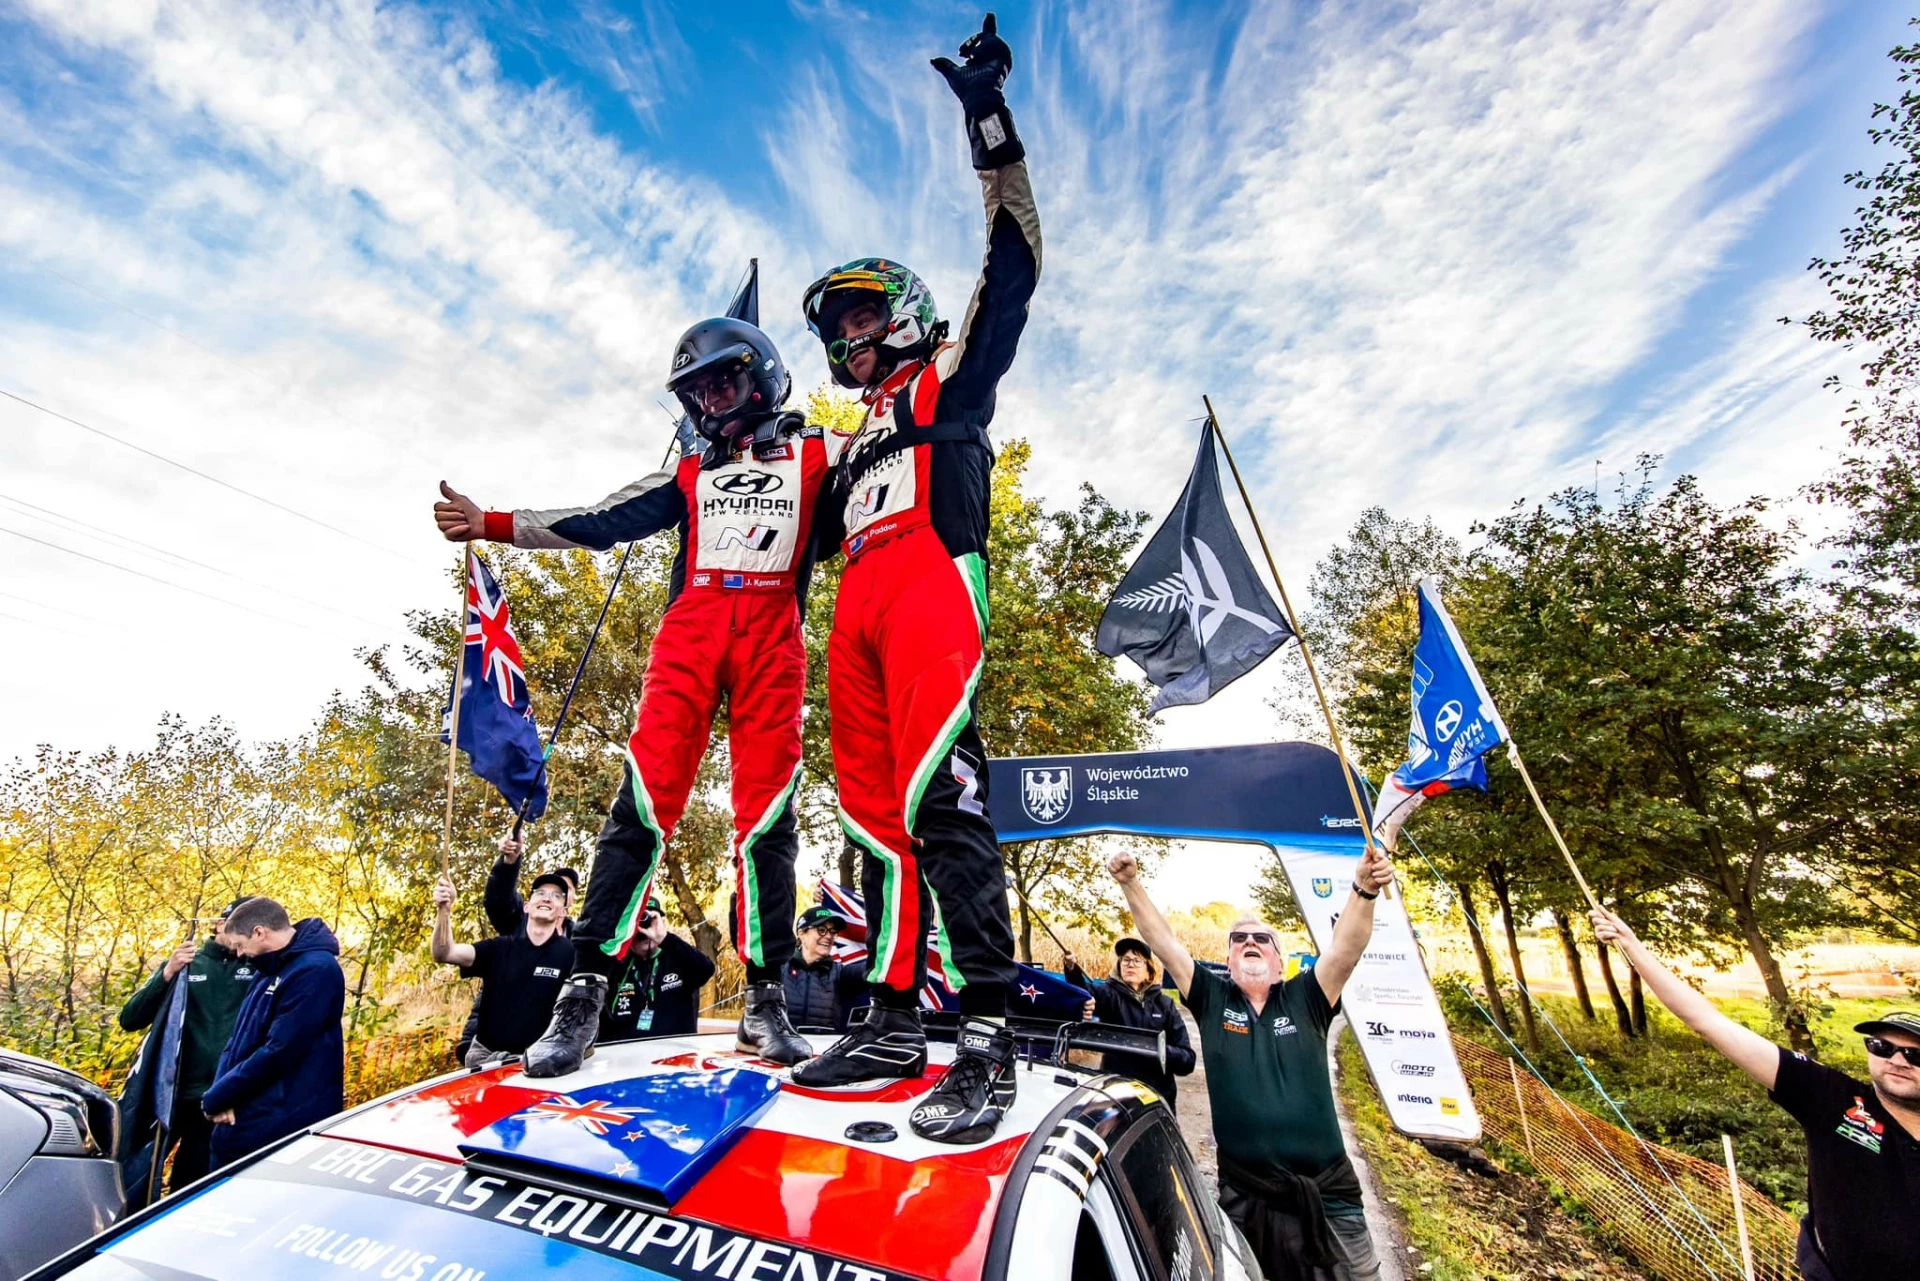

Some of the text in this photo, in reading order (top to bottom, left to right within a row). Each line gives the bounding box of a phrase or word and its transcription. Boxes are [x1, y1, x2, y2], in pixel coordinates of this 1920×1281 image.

[703, 496, 794, 512] HYUNDAI
[703, 509, 793, 519] NEW ZEALAND
[869, 522, 897, 537] Paddon
[692, 575, 711, 586] OMP
[753, 578, 780, 587] Kennard
[1086, 764, 1189, 784] Województwo
[1087, 785, 1139, 804] Śląskie
[964, 1037, 991, 1048] OMP
[912, 1105, 949, 1121] OMP
[309, 1145, 397, 1184] BRC
[388, 1162, 505, 1212] GAS
[273, 1223, 396, 1272] FOLLOW
[380, 1250, 438, 1281] US
